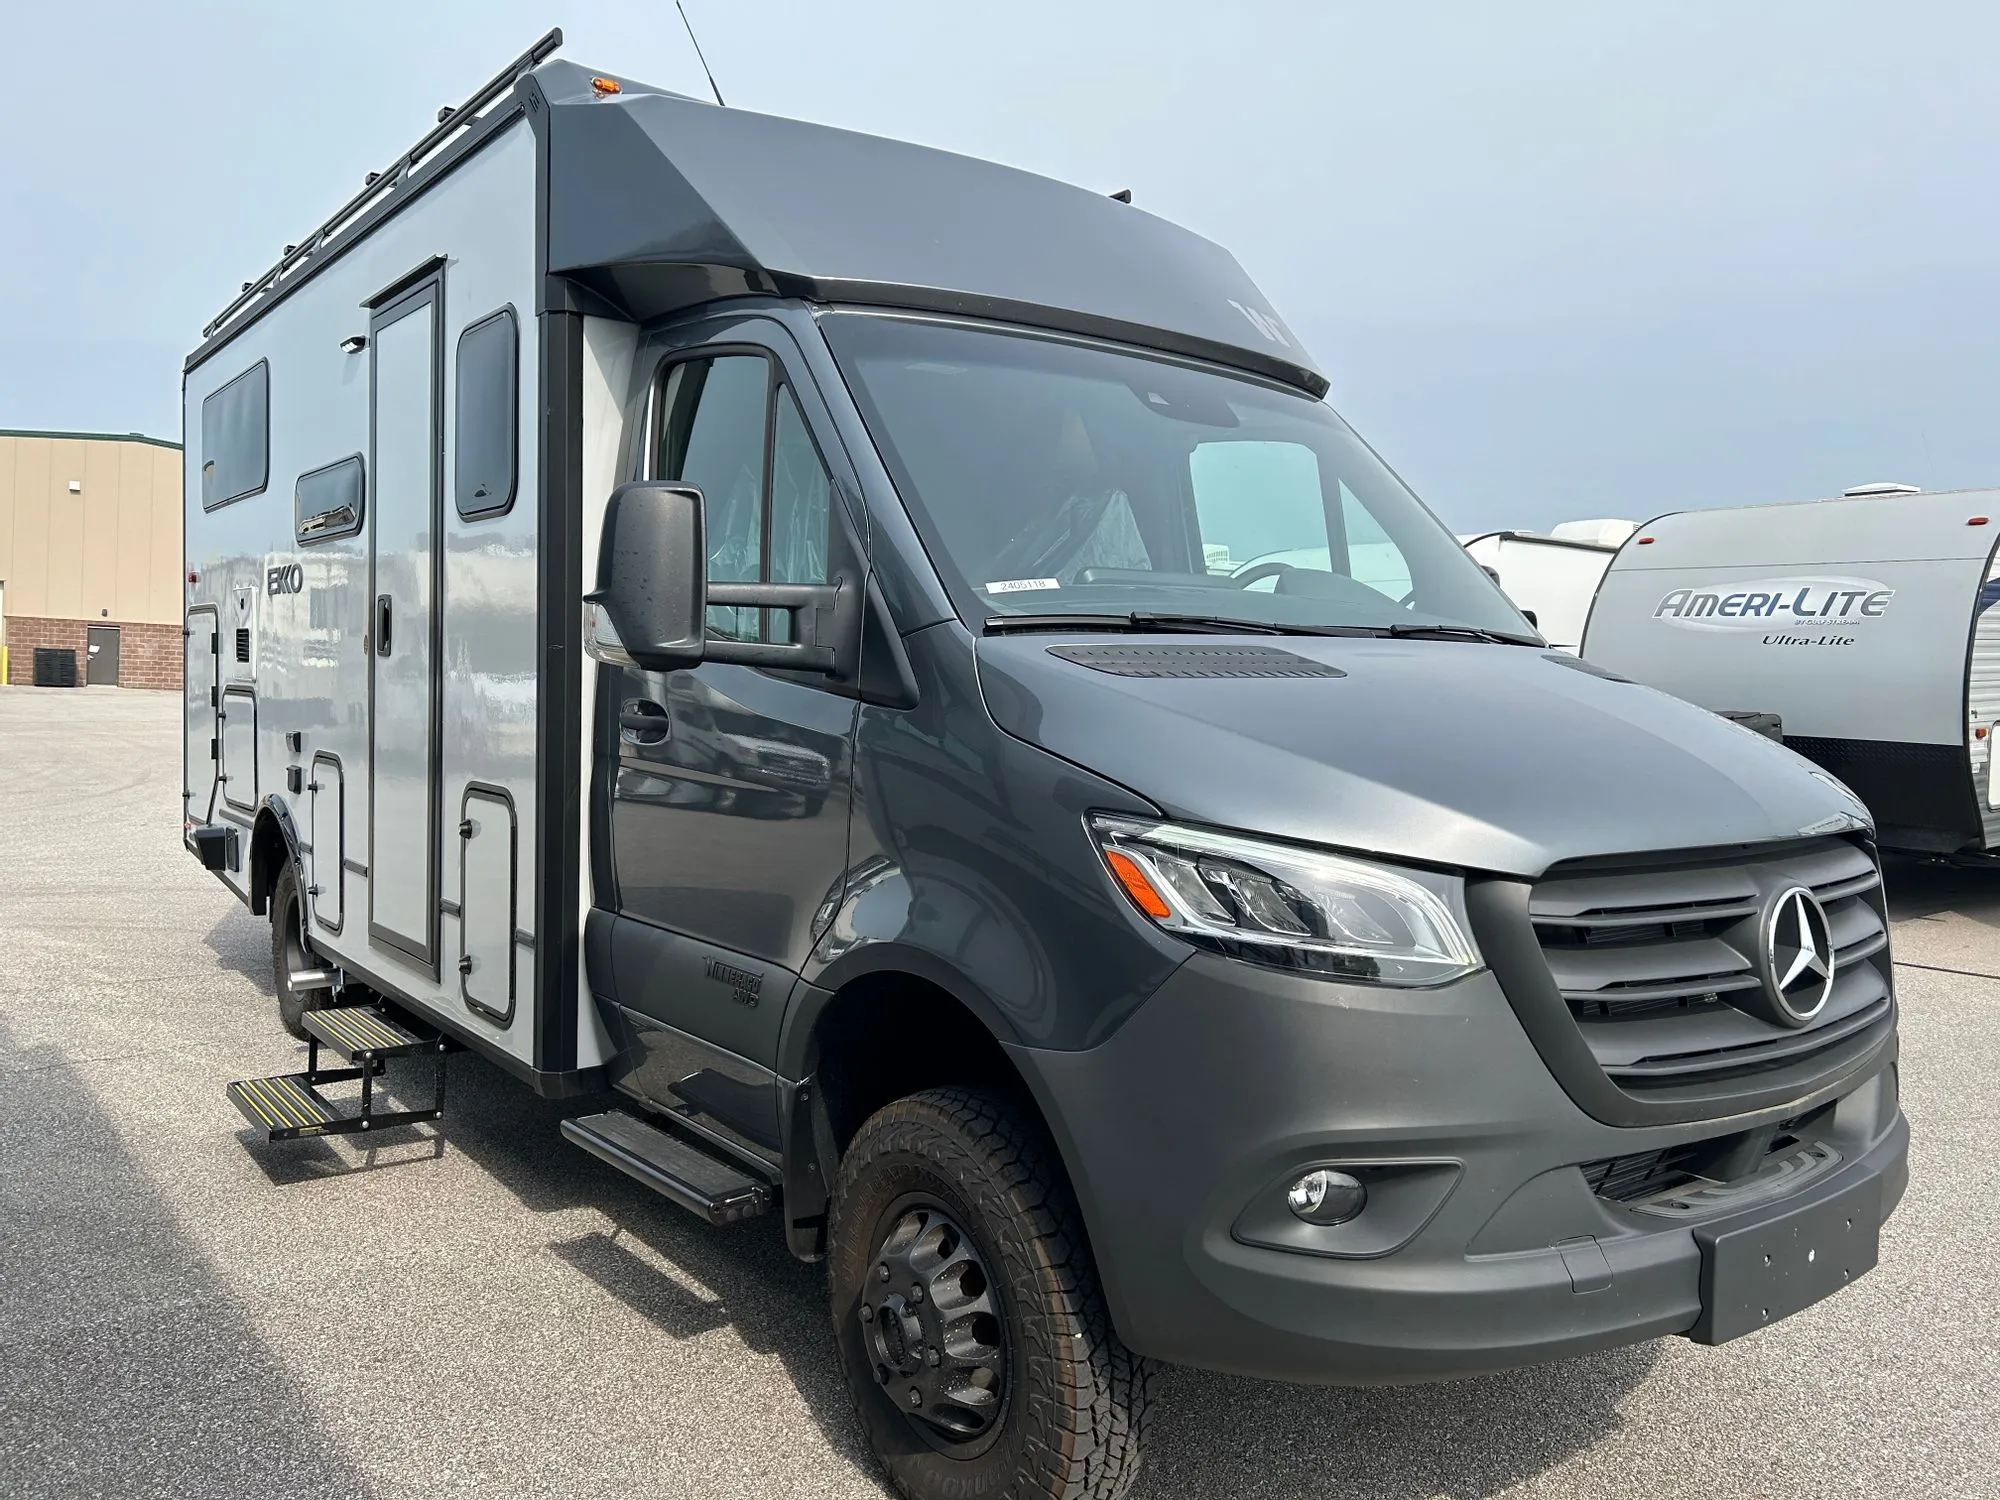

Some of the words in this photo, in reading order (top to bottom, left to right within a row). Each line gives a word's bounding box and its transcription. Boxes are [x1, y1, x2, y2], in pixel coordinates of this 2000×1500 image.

[267, 563, 304, 595] EKKO
[1000, 580, 1046, 592] 2405118
[1652, 586, 1896, 619] AMERI-LITE
[1762, 634, 1855, 647] Ultra-Lite
